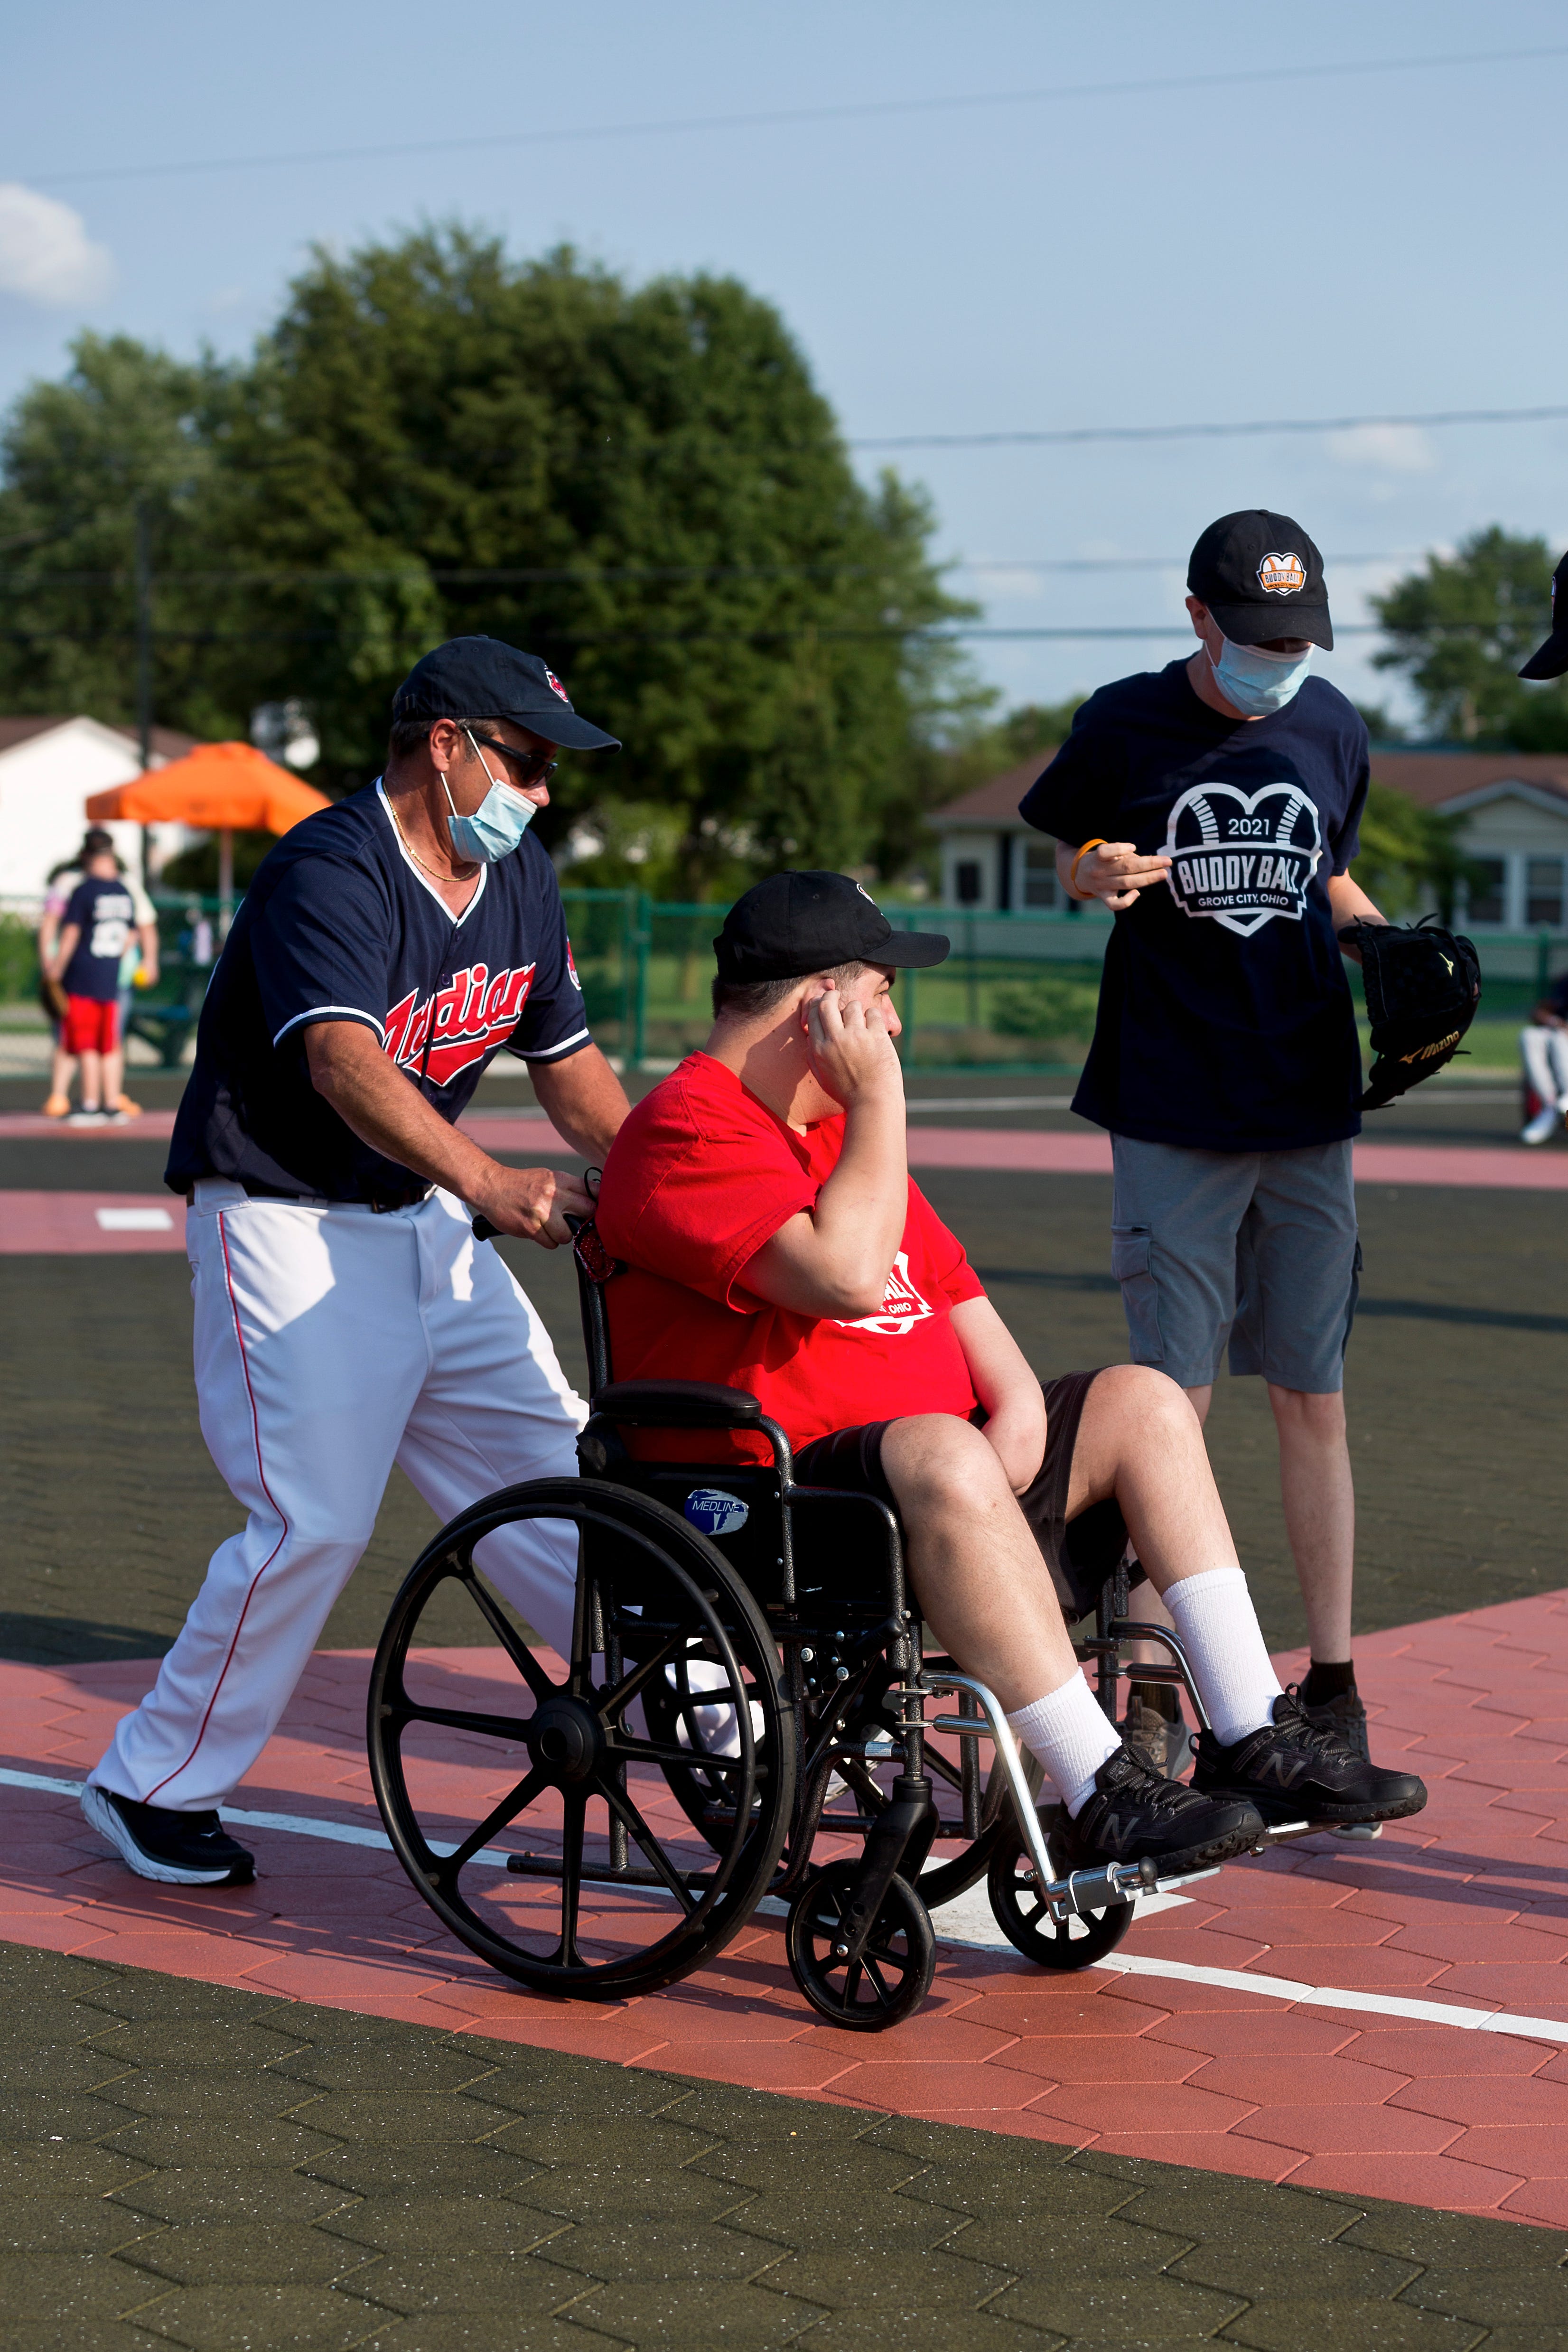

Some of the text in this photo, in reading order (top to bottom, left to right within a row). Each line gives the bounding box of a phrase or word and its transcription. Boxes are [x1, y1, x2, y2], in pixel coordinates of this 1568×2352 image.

[1264, 572, 1299, 583] BUDDY BALL
[1228, 819, 1269, 835] 2021
[1177, 856, 1300, 894] BUDDY BALL
[1198, 894, 1288, 906] GROVE CITY, OHIO
[383, 962, 536, 1064] Indian
[883, 1272, 914, 1301] ALL
[888, 1302, 912, 1314] OHIO
[692, 1501, 739, 1512] MEDLINE
[1256, 1752, 1307, 1788] N
[1098, 1813, 1140, 1851] N
